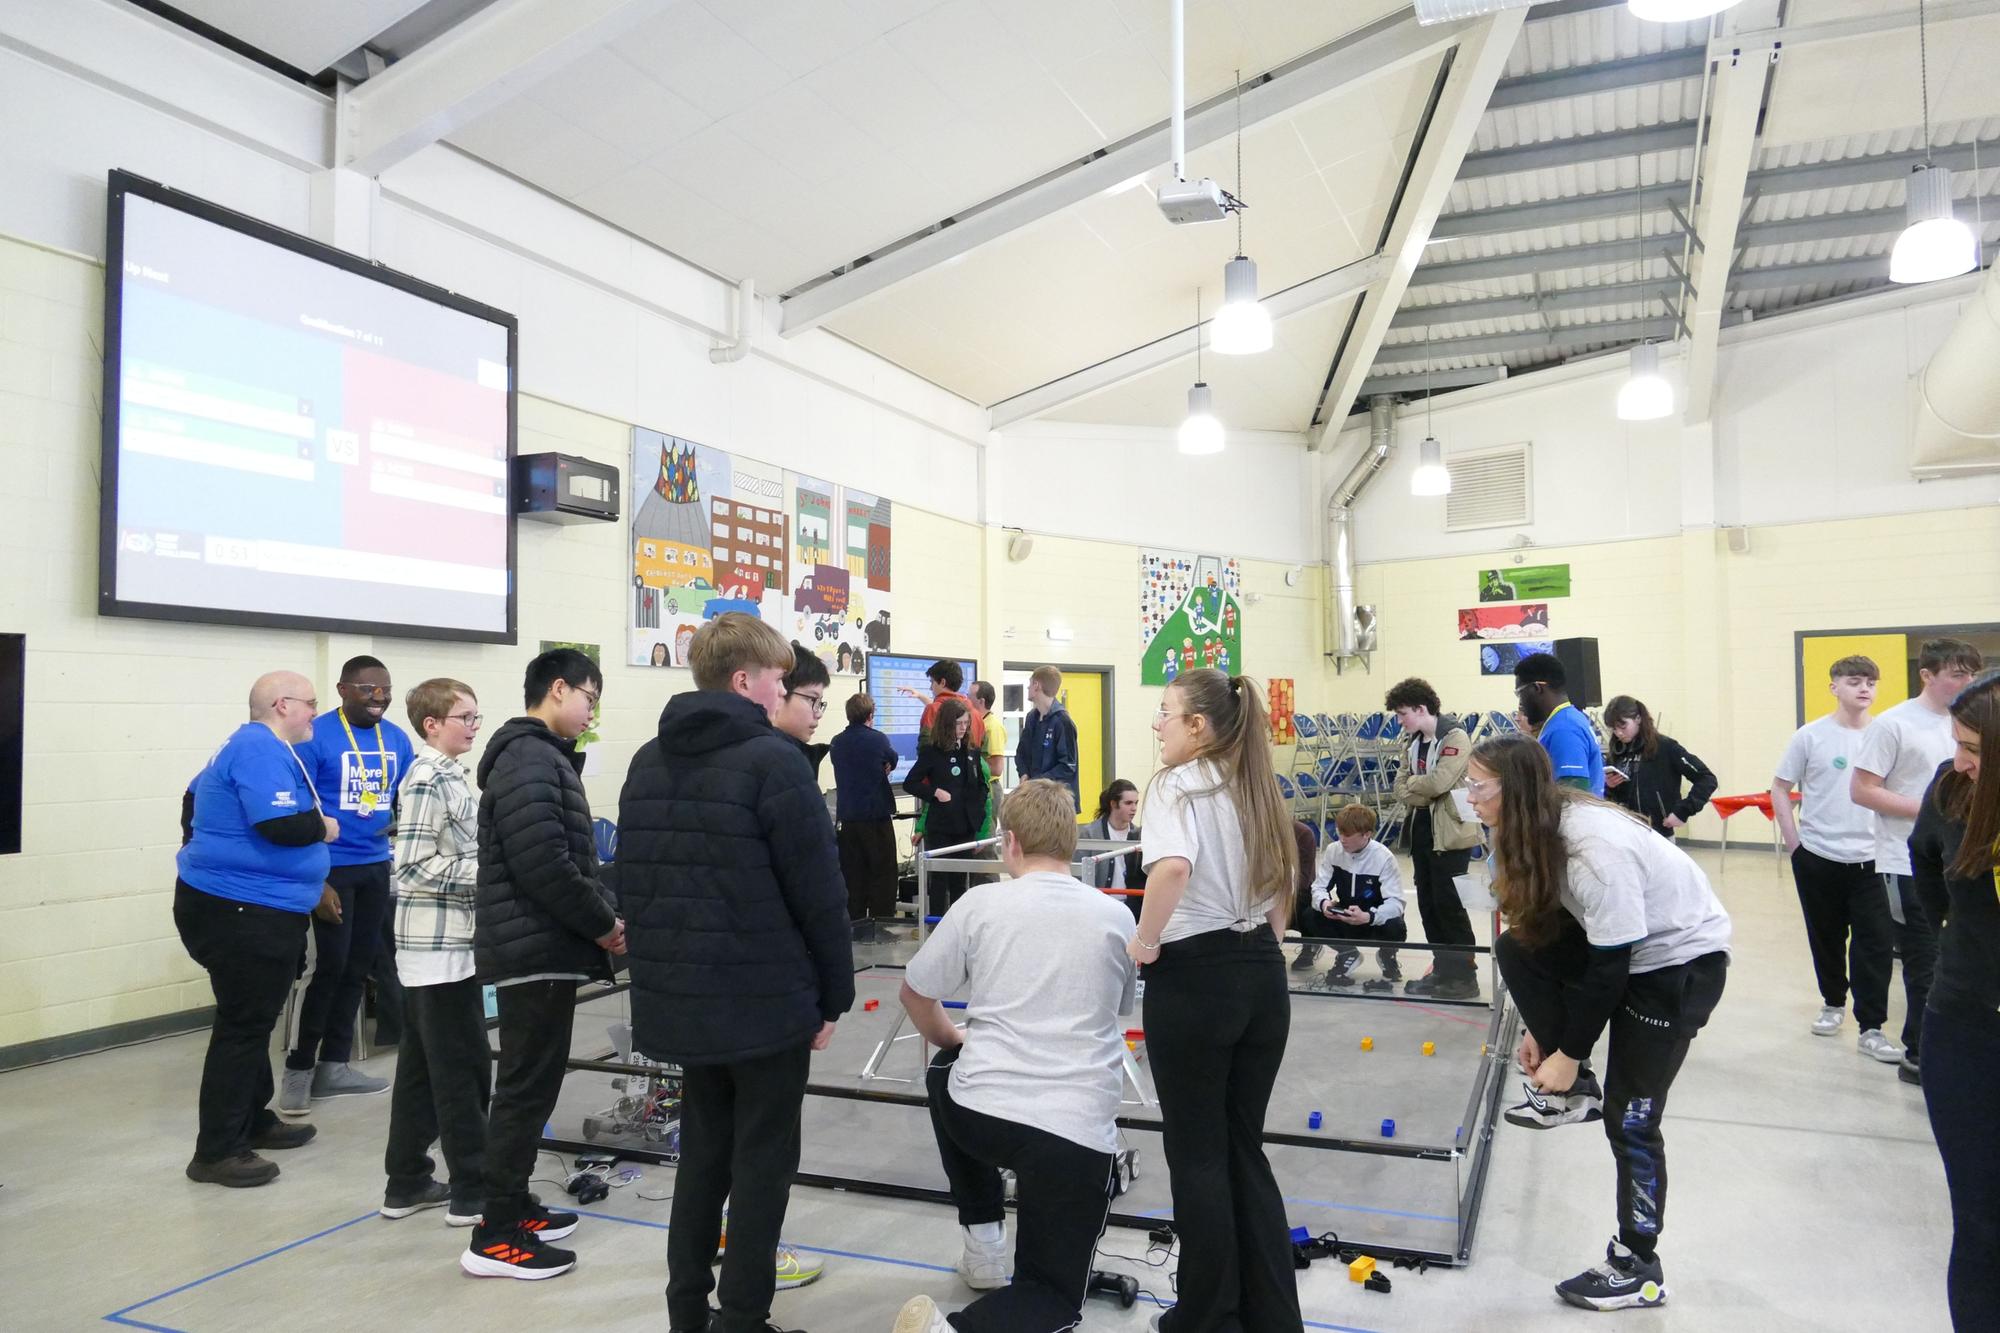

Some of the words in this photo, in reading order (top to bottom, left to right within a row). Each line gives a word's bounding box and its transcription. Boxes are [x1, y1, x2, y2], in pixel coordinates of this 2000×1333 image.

[142, 266, 169, 283] Next
[331, 436, 354, 457] VS
[350, 766, 383, 778] More
[350, 779, 380, 791] Than
[349, 791, 391, 803] Rots
